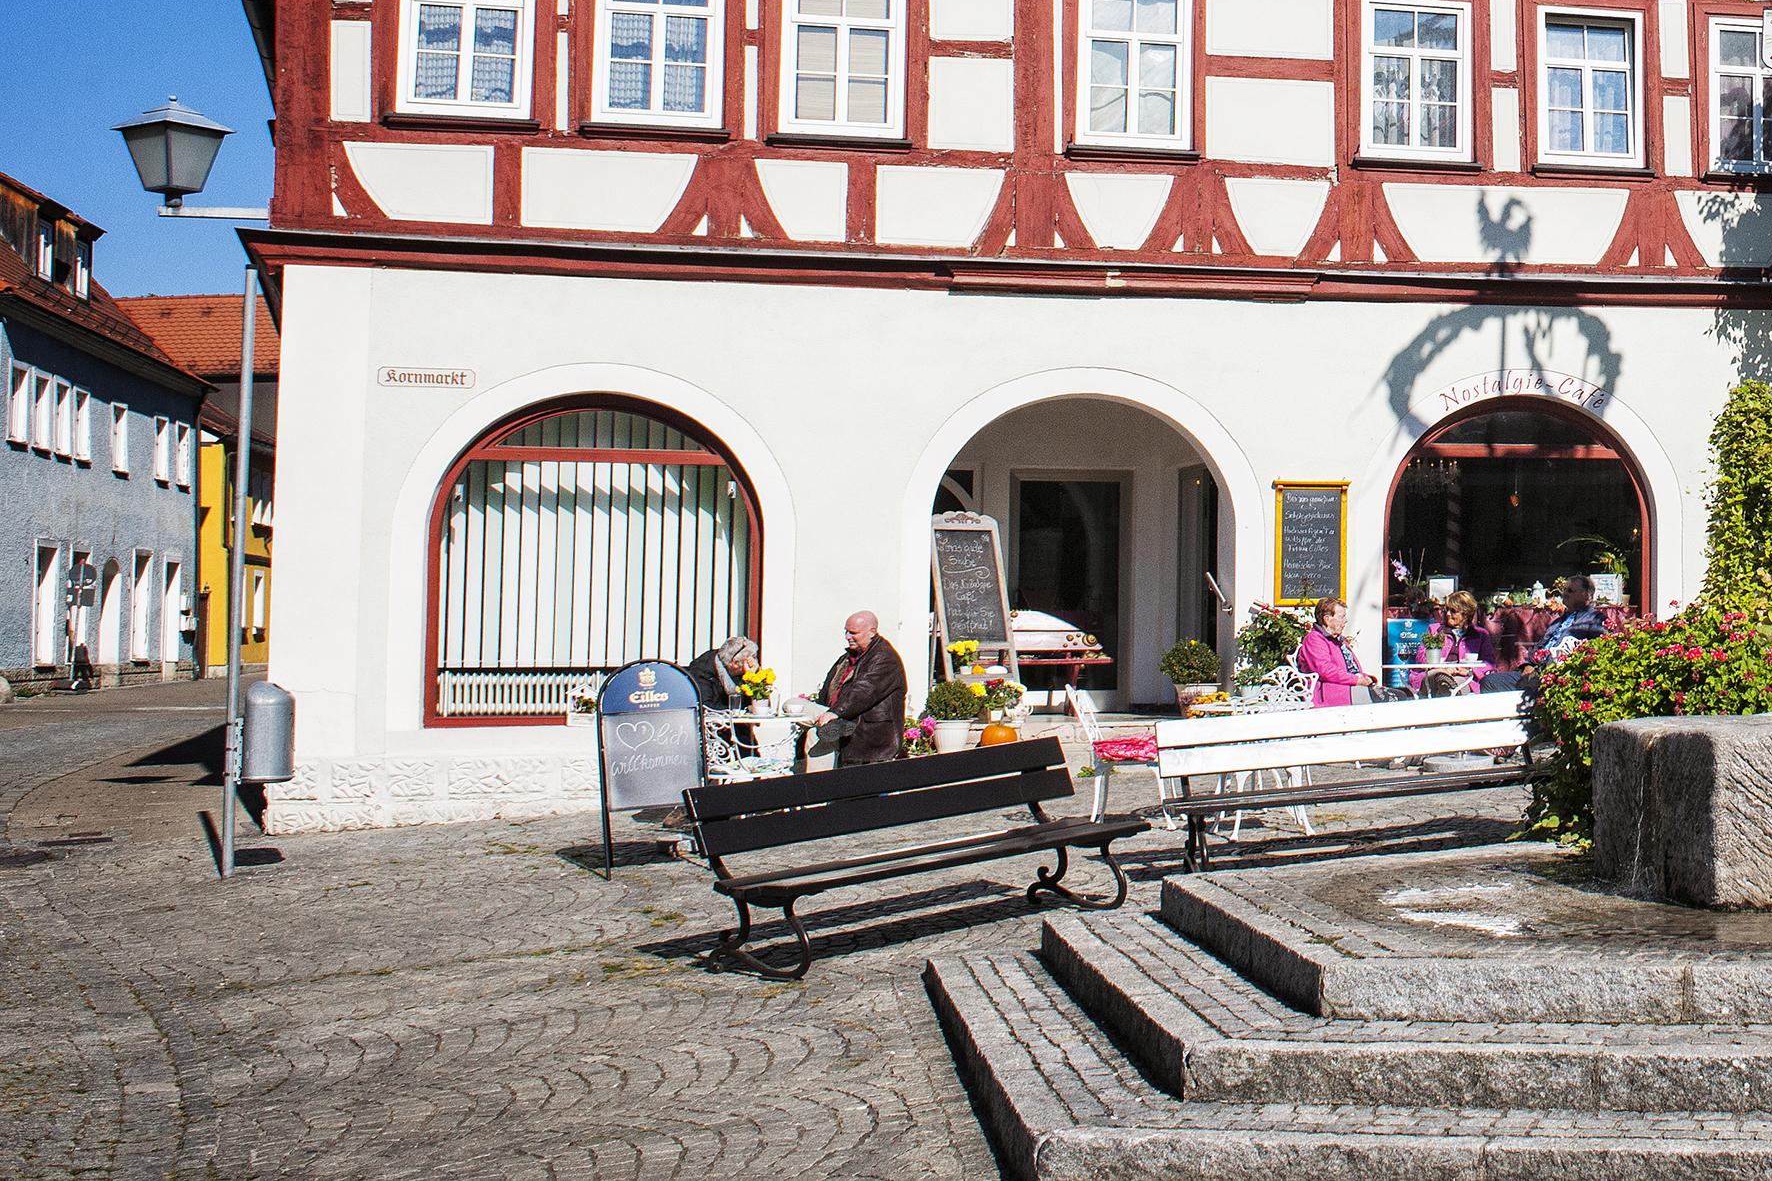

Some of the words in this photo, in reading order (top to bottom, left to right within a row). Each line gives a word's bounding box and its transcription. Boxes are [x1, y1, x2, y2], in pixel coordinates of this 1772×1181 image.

[385, 369, 467, 385] Kornmarkt
[1439, 370, 1604, 411] Nostalgie-Café
[628, 690, 669, 704] Eilles
